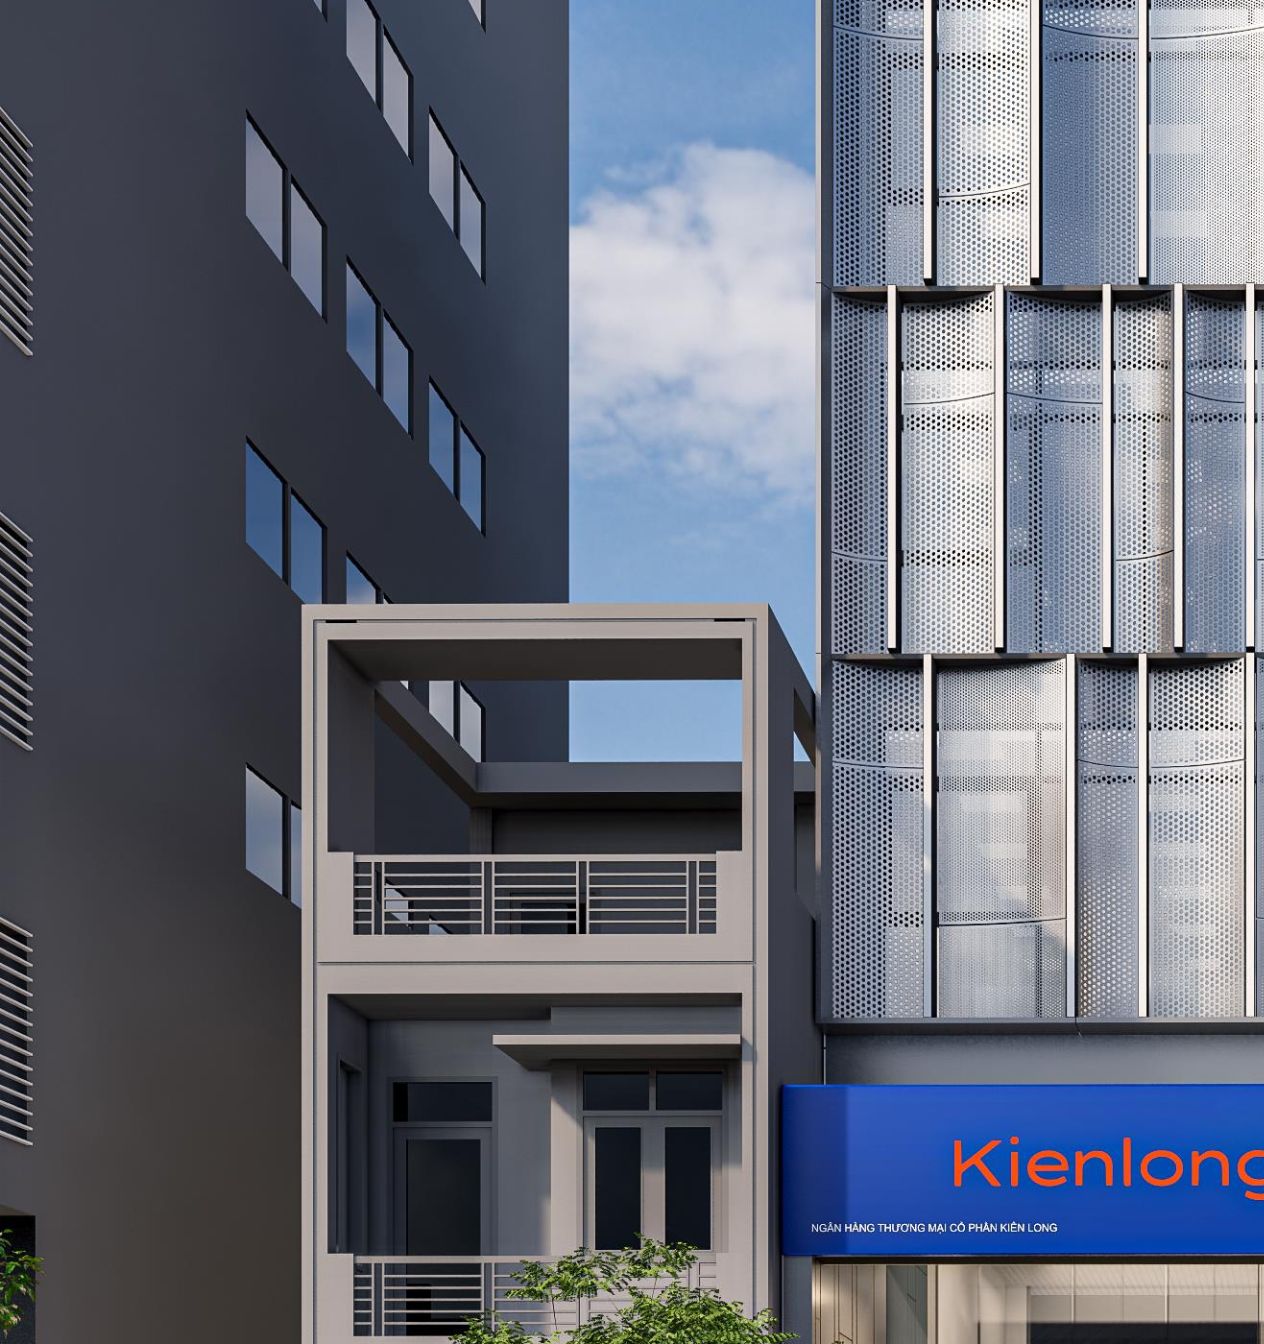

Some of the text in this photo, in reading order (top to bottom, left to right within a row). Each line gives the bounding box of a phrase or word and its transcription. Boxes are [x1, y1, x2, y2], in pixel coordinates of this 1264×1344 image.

[811, 1222, 841, 1233] NGÂN
[844, 1221, 875, 1233] HÀNG
[877, 1223, 926, 1233] THƯƠNG
[928, 1223, 947, 1235] MẠI
[1000, 1221, 1025, 1233] KIÊN
[1027, 1223, 1058, 1233] LONG
